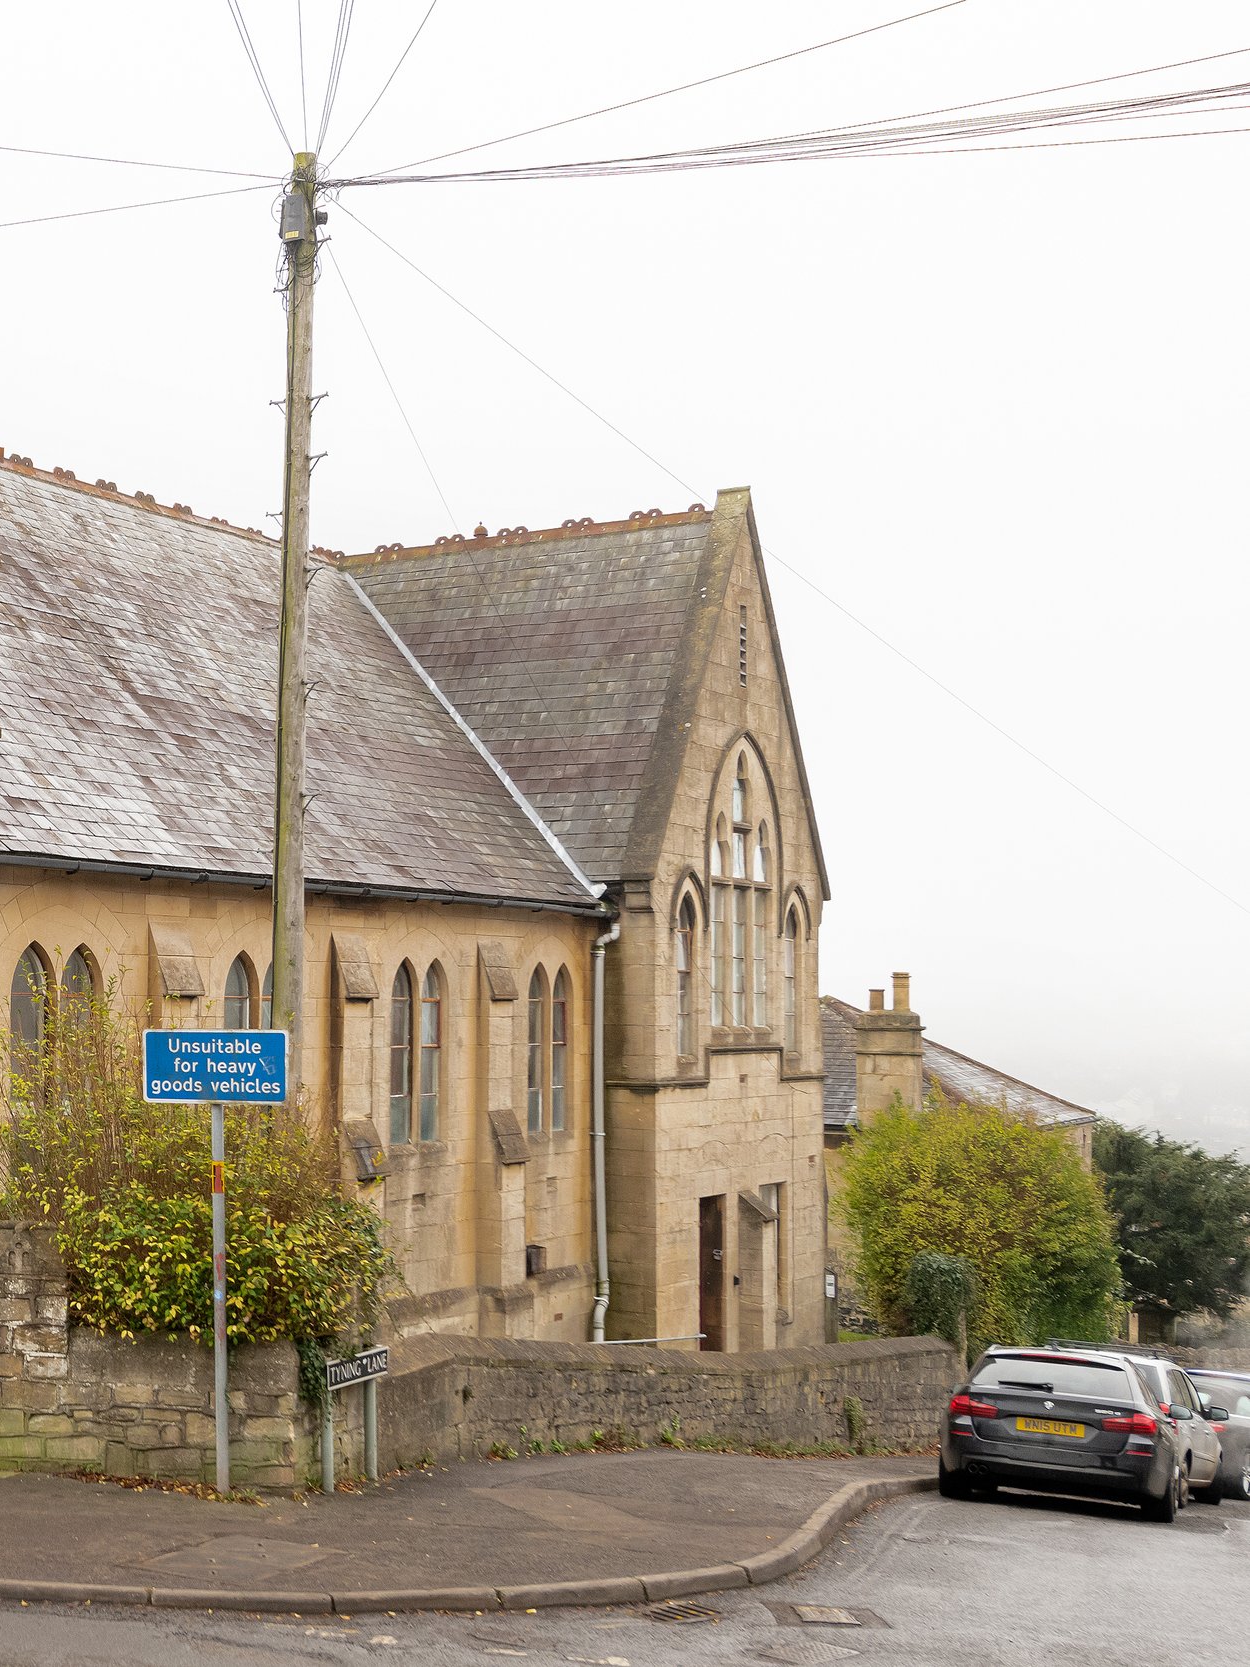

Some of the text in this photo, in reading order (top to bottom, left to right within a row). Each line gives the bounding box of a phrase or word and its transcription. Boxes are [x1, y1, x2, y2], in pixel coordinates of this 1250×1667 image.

[168, 1038, 262, 1054] Unsuitable
[173, 1057, 257, 1076] for heavy
[151, 1077, 281, 1095] goods vehicles
[330, 1353, 388, 1384] TYNING LANE
[1053, 1422, 1077, 1435] UTM
